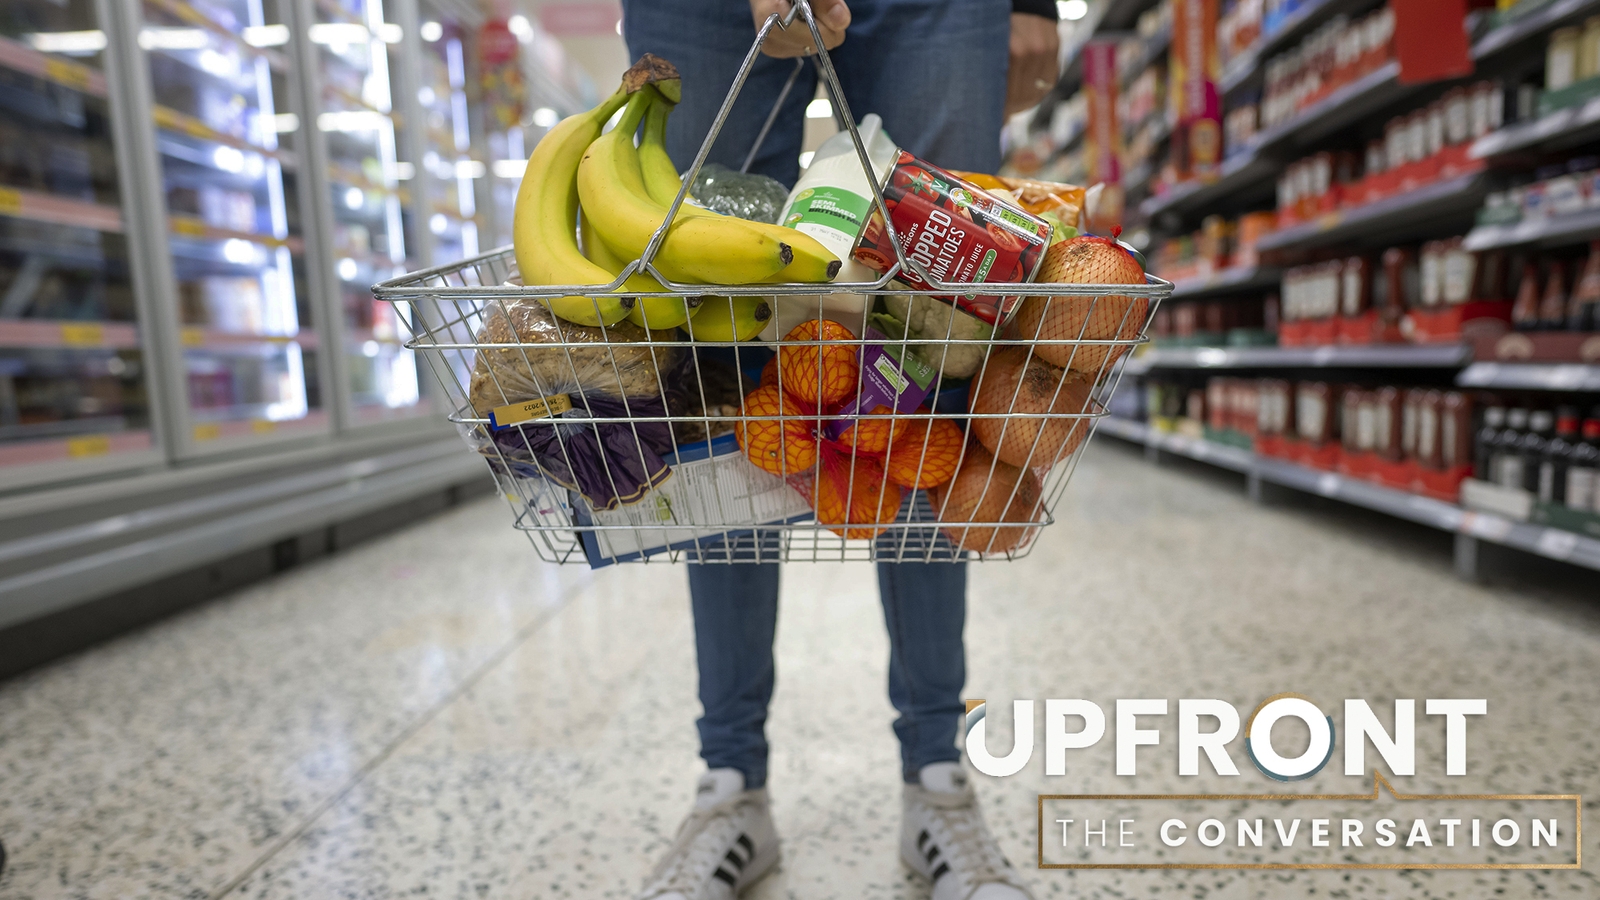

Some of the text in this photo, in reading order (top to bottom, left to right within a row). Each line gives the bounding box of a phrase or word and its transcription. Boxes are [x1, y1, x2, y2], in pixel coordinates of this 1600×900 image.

[808, 207, 846, 219] BRITISH
[809, 204, 857, 219] SKIMMED
[810, 199, 836, 208] SEMI
[902, 222, 919, 254] orrisons
[902, 209, 952, 283] COPPED
[928, 226, 966, 283] OMATOES
[958, 242, 984, 284] OMATO JUICE
[979, 269, 987, 277] 5
[985, 255, 993, 266] DAY
[524, 403, 540, 411] 2022
